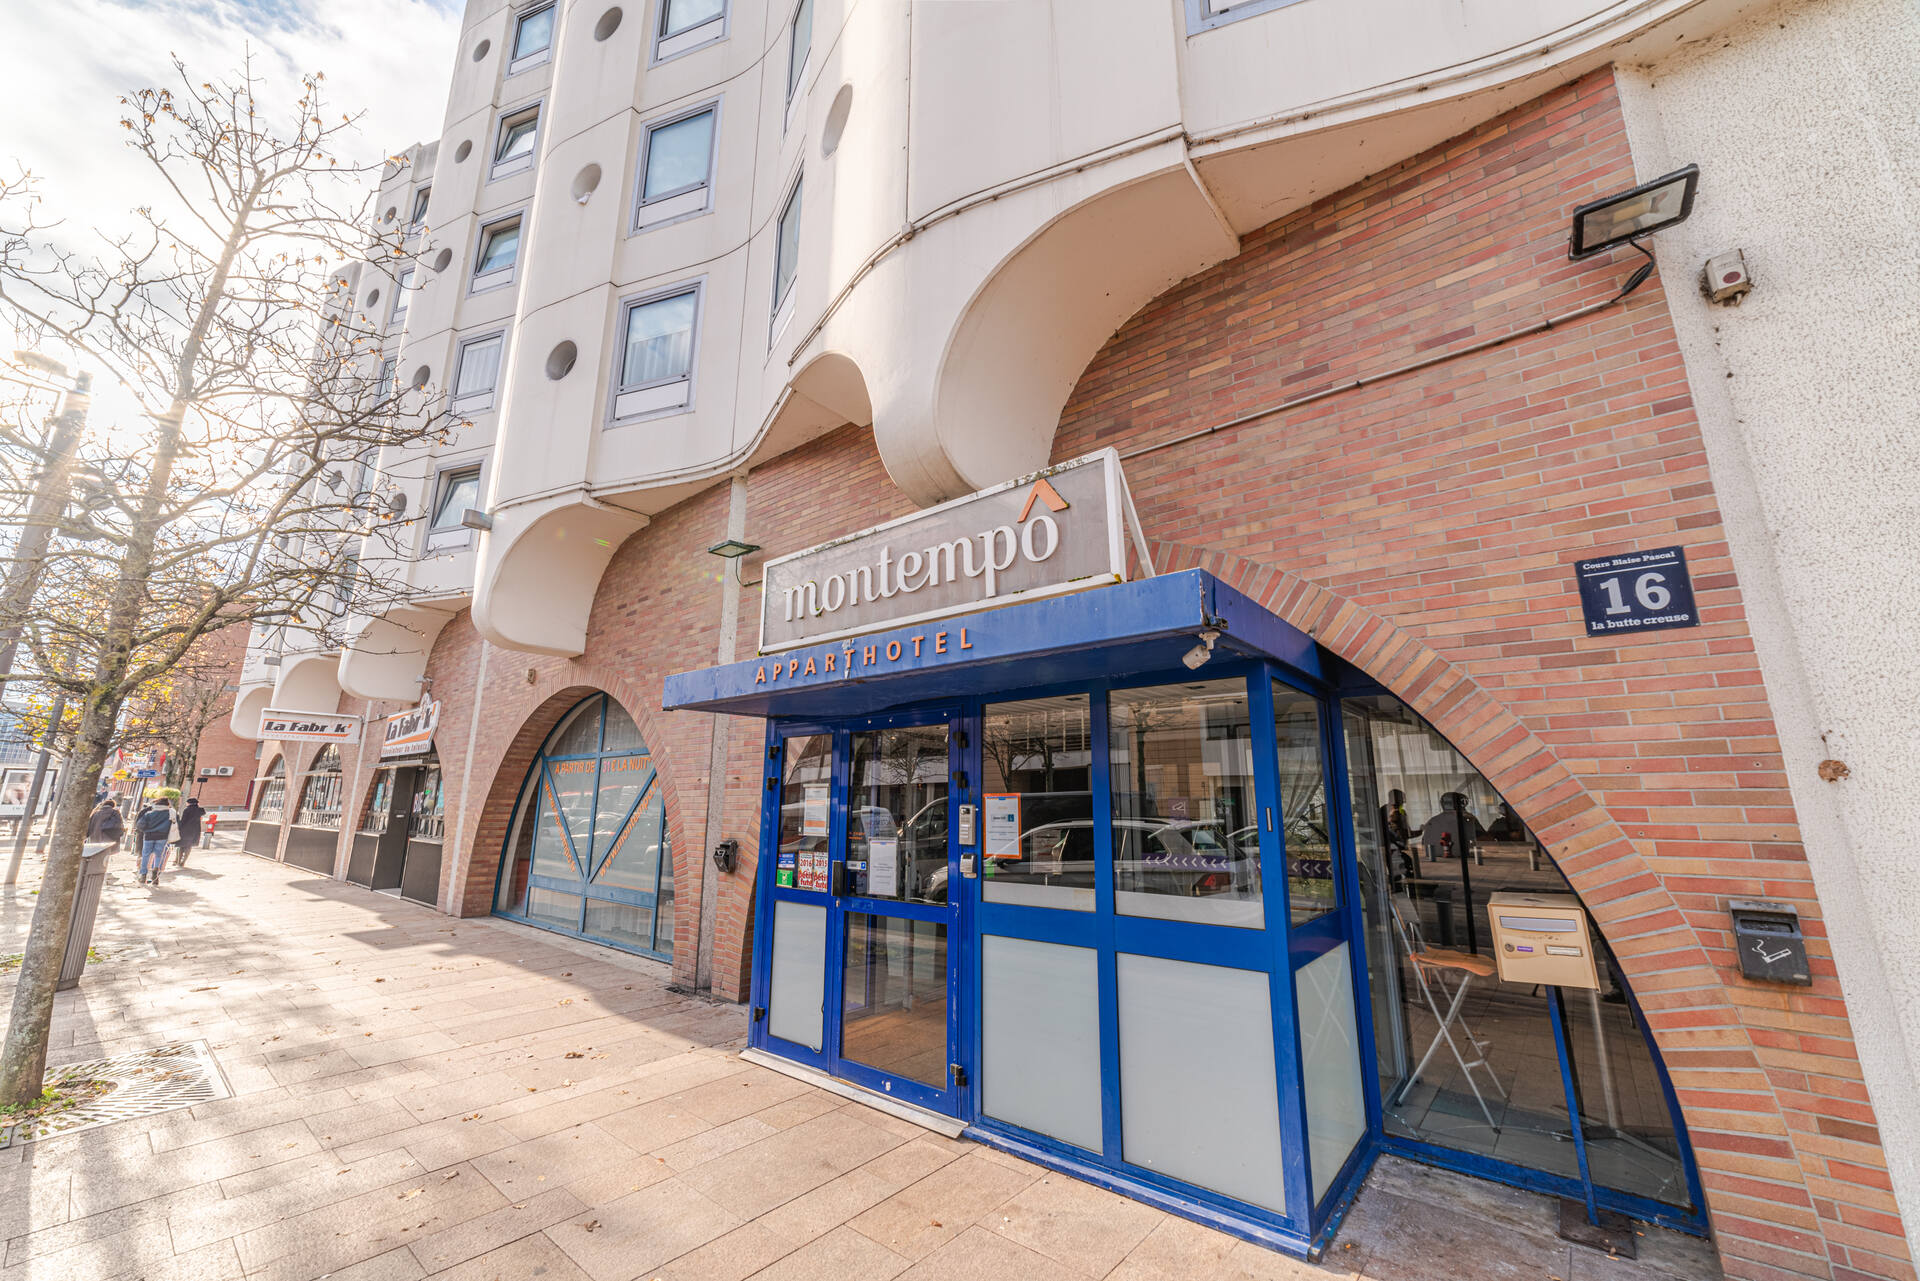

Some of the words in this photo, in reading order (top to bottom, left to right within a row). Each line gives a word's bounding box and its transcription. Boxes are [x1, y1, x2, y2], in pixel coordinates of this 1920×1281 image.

[1583, 561, 1610, 570] Cours
[1612, 557, 1641, 566] Blaise
[1642, 551, 1676, 562] Pascal
[1599, 572, 1671, 615] 16
[1591, 621, 1605, 630] la
[1607, 618, 1641, 629] butte
[1643, 613, 1689, 625] creuse
[755, 627, 972, 684] APPARTHOTEL
[264, 721, 286, 731] La
[385, 722, 398, 742] La
[561, 761, 584, 774] PARTIR
[585, 761, 596, 773] DE
[617, 758, 628, 772] LA
[800, 859, 813, 868] 2016
[816, 859, 828, 868] 2015
